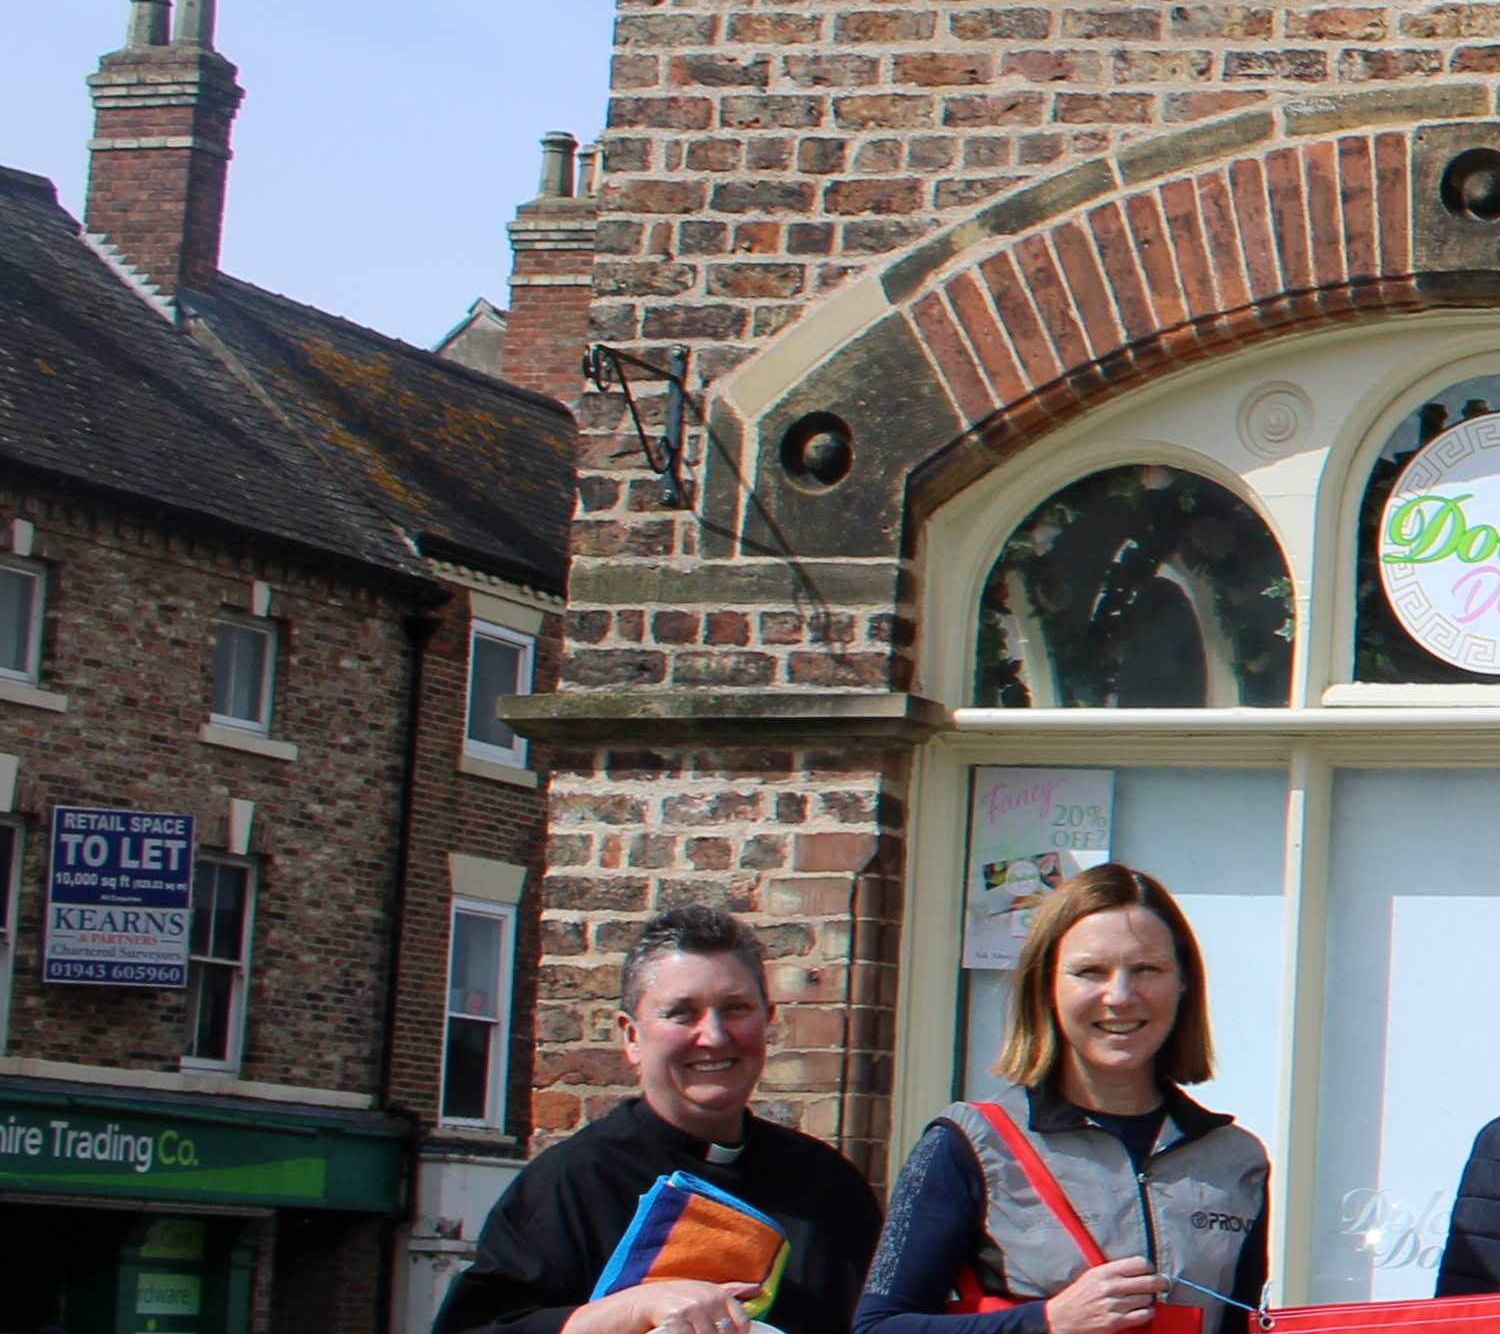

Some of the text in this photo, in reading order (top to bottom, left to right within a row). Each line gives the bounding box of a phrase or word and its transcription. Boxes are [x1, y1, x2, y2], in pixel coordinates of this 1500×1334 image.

[984, 778, 1069, 827] Fancy
[64, 813, 185, 835] RETAIL SPACE
[1053, 804, 1106, 828] 20%
[1052, 830, 1107, 848] OFF?
[60, 833, 187, 871] TO LET
[55, 872, 98, 887] 10,000
[101, 876, 116, 890] sq
[119, 874, 130, 888] ft
[55, 907, 185, 936] KEARNS
[51, 943, 116, 958] Chartered
[51, 961, 181, 982] 01943 605960
[49, 1120, 153, 1173] Trading
[158, 1130, 198, 1166] Co.
[1209, 1212, 1257, 1233] PROV
